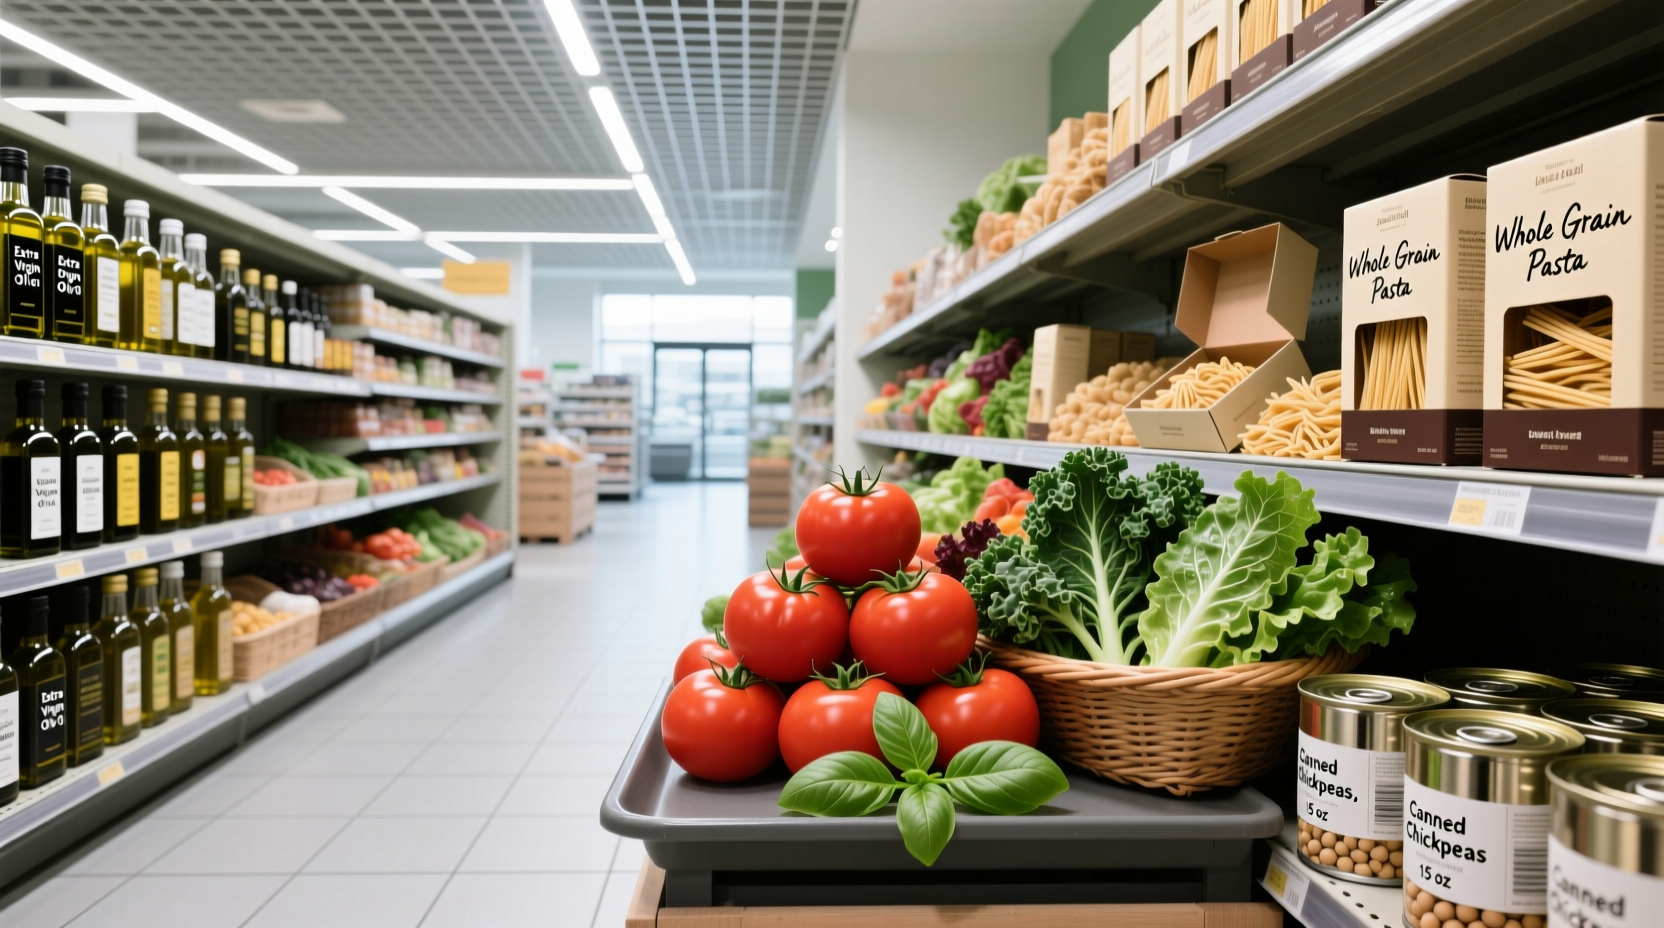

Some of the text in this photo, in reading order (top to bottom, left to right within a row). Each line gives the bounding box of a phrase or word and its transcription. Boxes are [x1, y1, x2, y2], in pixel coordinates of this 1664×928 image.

[1496, 201, 1632, 253] Whole Grain
[1349, 239, 1441, 279] Whole Grain
[1527, 247, 1589, 282] Pasta
[1371, 275, 1413, 304] Pasta
[1315, 808, 1329, 822] oz
[1409, 800, 1467, 836] Canned
[1406, 820, 1488, 863] Chickpeas
[1419, 863, 1452, 890] 15 oz
[1552, 864, 1626, 918] Canned
